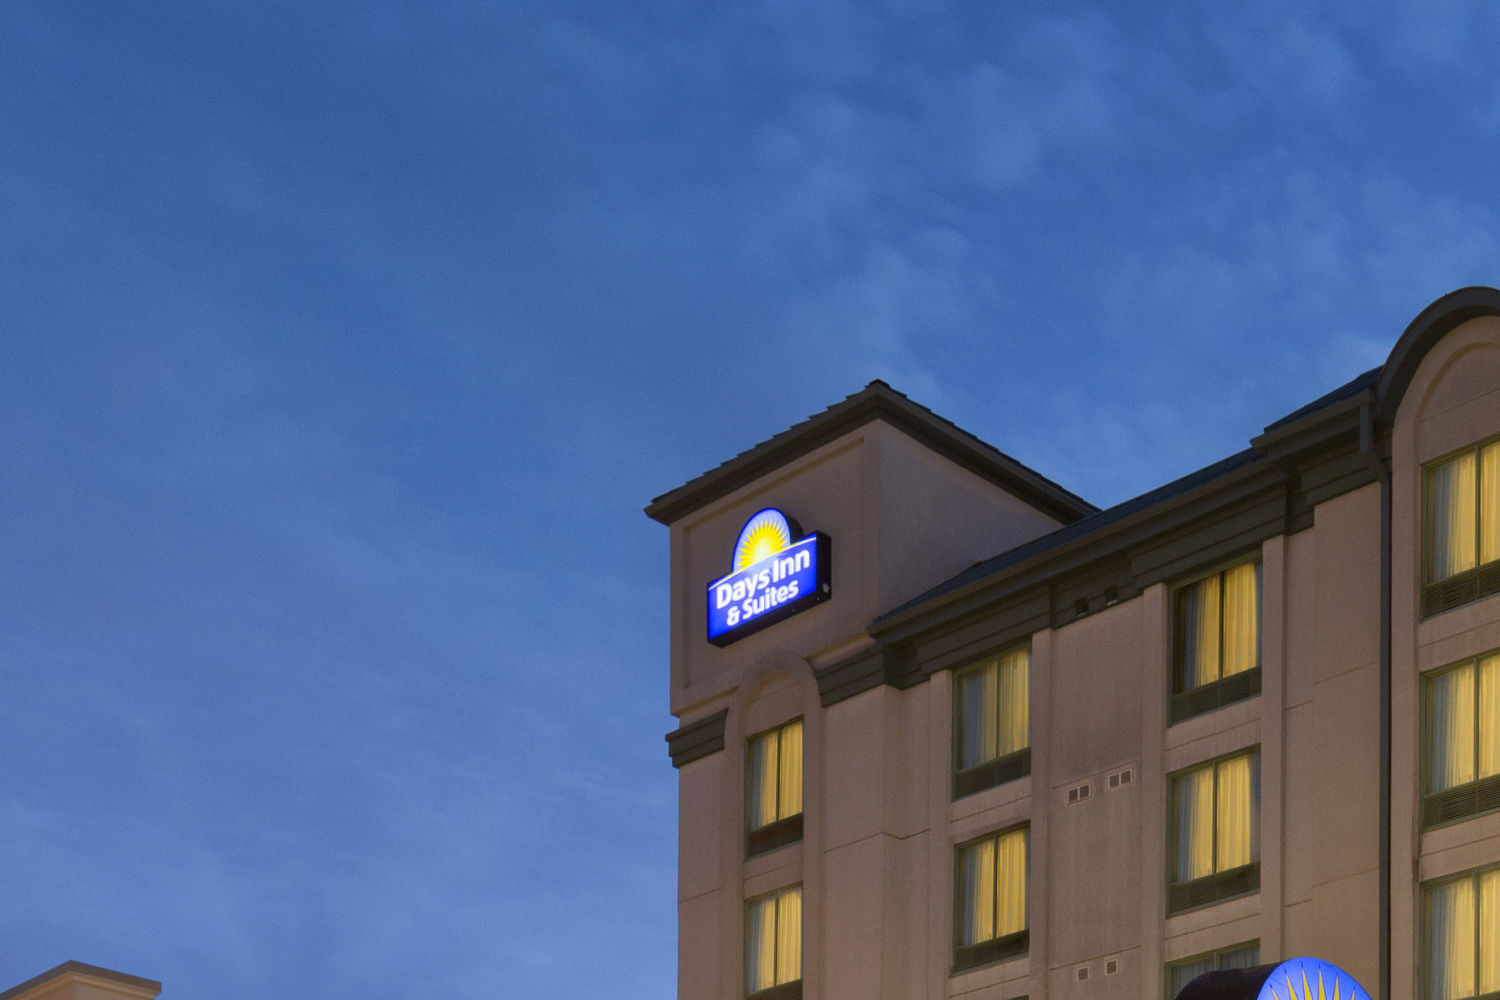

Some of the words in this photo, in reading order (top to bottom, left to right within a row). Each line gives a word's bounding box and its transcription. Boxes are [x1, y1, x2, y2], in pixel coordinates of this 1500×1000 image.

[716, 568, 770, 609] Days
[772, 549, 810, 583] Inn
[726, 606, 740, 626] &
[742, 580, 799, 620] Suites
